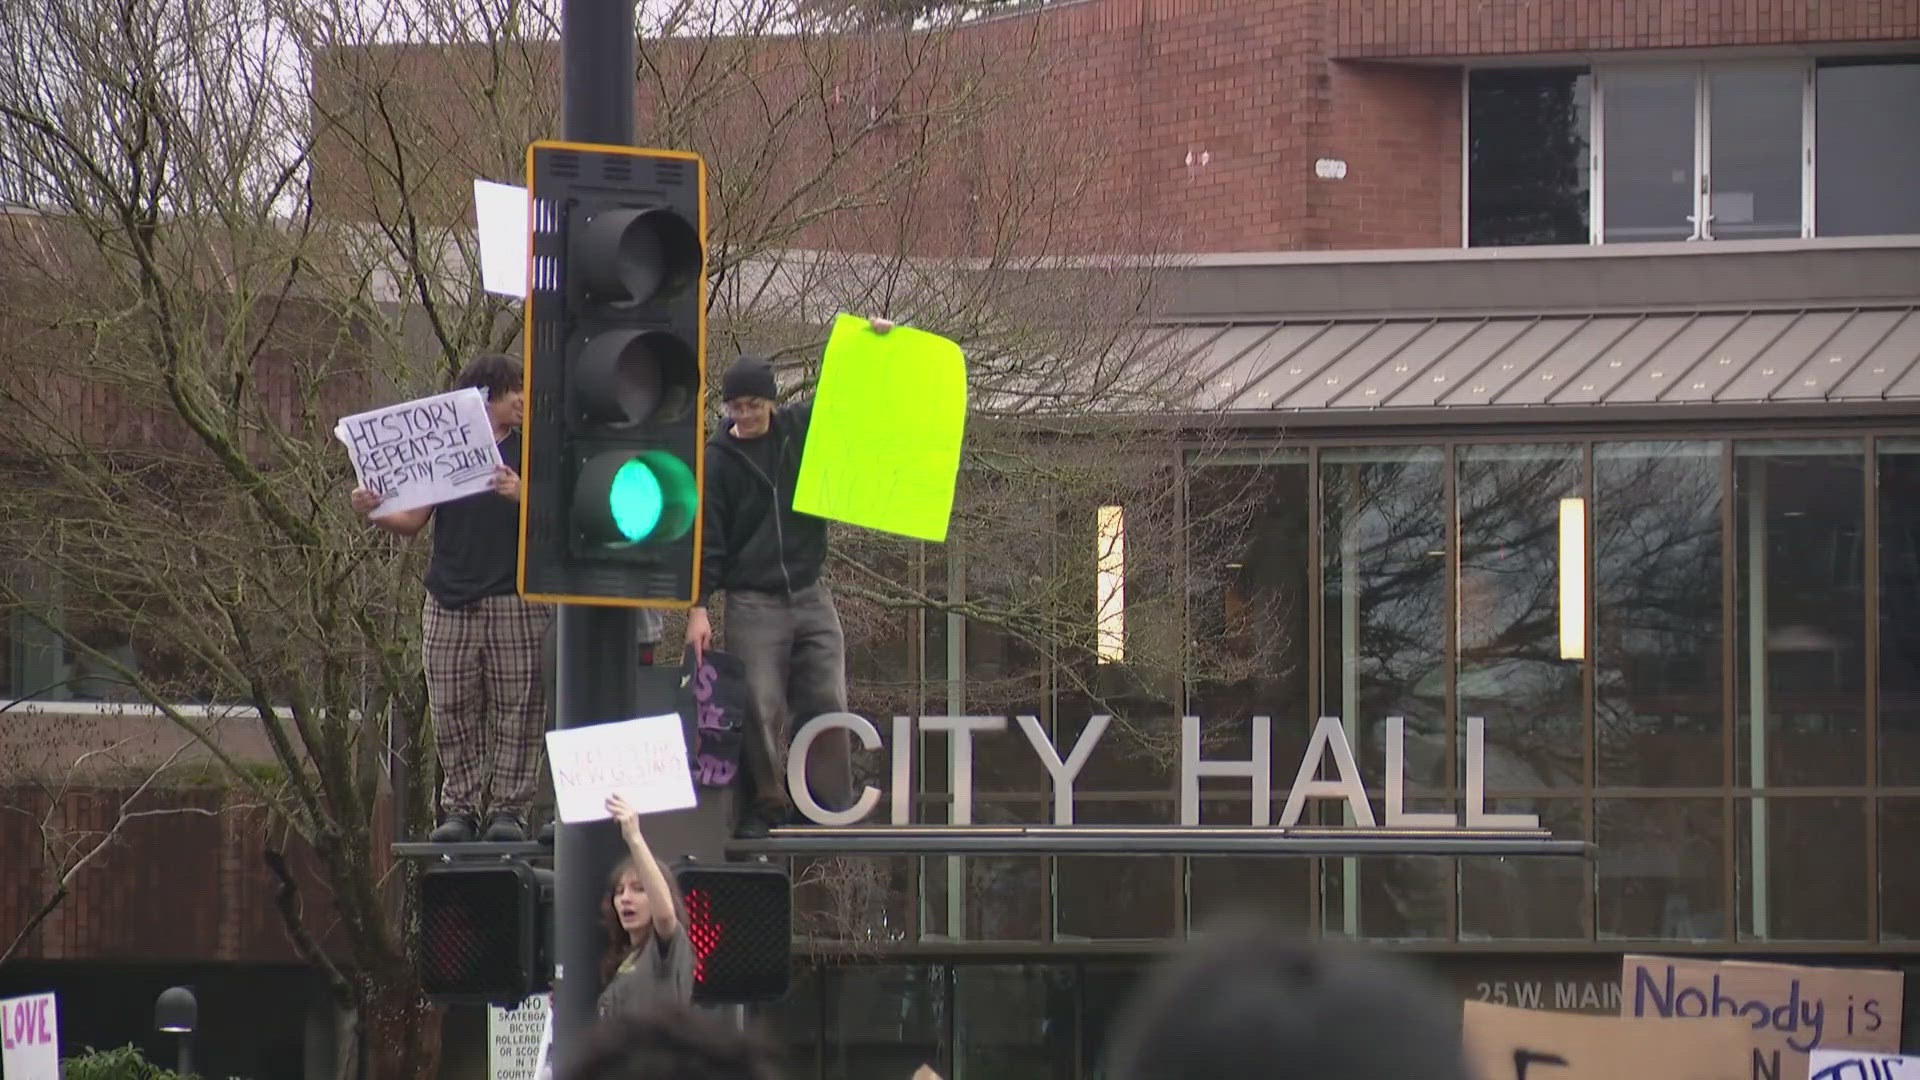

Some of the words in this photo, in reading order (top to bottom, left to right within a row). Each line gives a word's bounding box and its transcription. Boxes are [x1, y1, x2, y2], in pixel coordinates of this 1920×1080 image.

[346, 400, 459, 451] HISTORY
[357, 431, 445, 476] REPEATS
[446, 423, 472, 449] IF
[363, 471, 395, 497] WE
[394, 461, 435, 485] STAY
[435, 444, 496, 477] SILENT
[786, 711, 1113, 827] CITY
[1181, 715, 1540, 827] HALL
[522, 997, 541, 1010] NO
[1477, 982, 1508, 1006] 25
[1514, 982, 1545, 1008] W.
[1635, 965, 1824, 1052] Nobody
[1847, 995, 1882, 1034] is
[3, 998, 51, 1049] LOVE
[499, 1047, 512, 1057] OR
